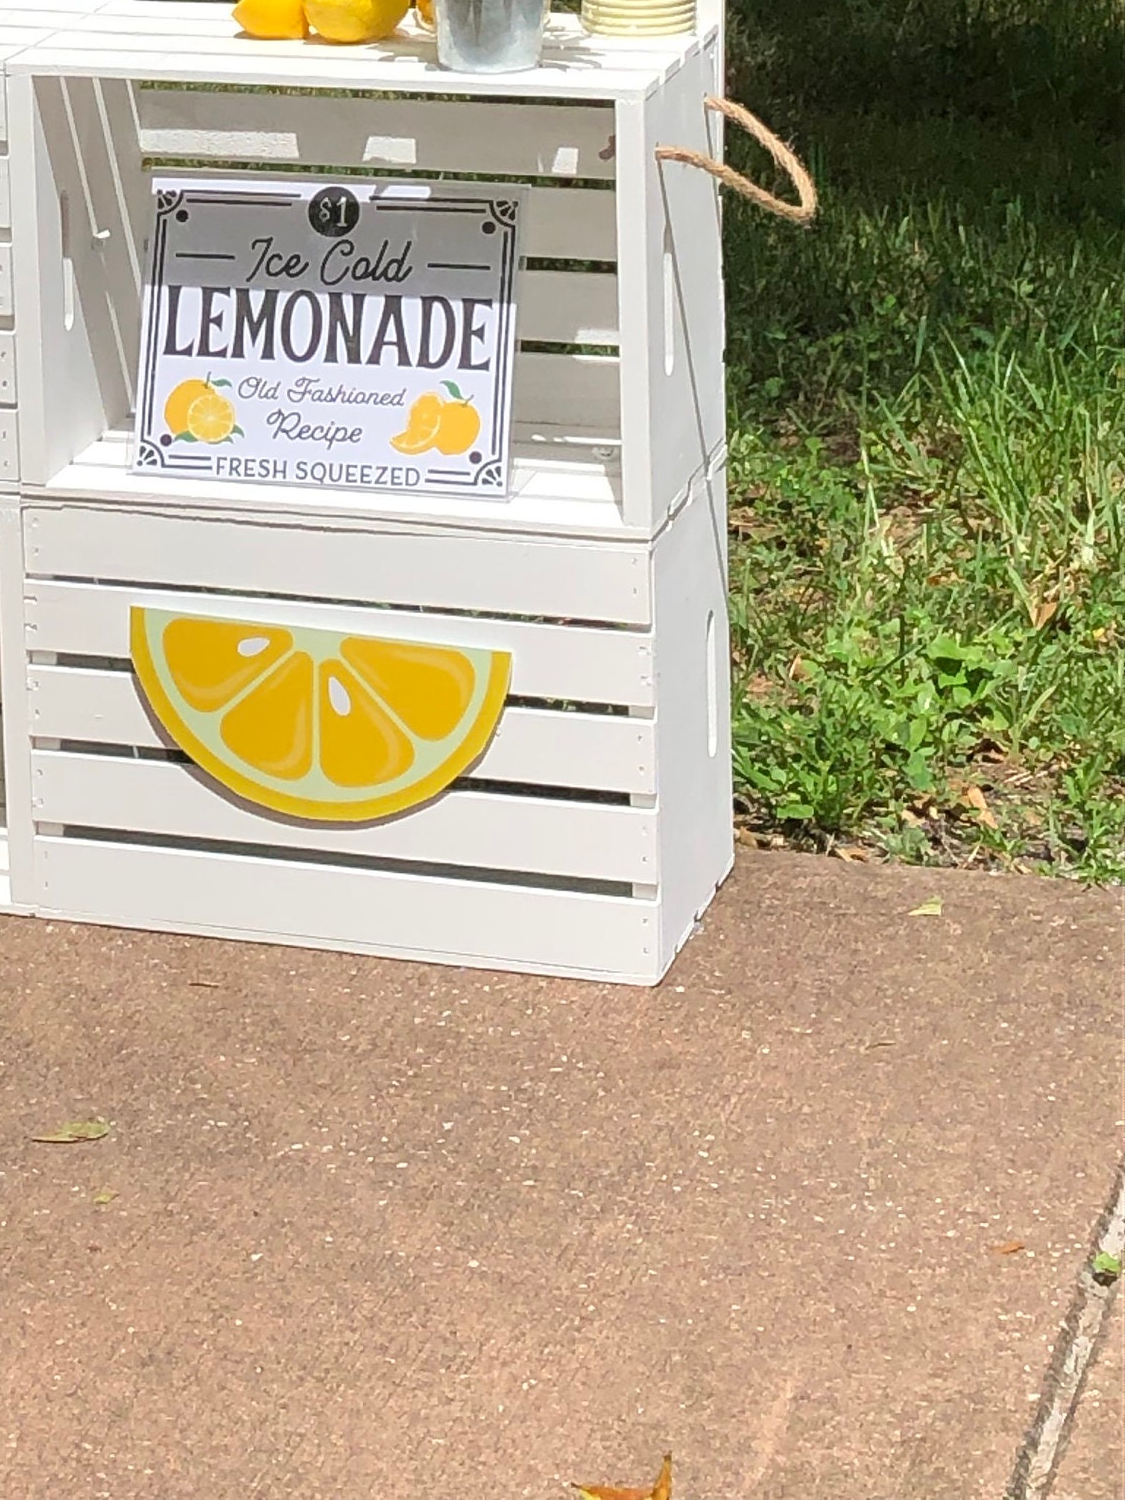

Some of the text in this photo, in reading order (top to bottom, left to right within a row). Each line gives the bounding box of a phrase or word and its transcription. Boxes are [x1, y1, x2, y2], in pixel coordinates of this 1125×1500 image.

[317, 195, 351, 228] $1
[245, 237, 413, 286] Ice Cold
[163, 284, 493, 372] LEMONADE
[237, 376, 406, 408] Old Fashioned
[266, 409, 363, 451] Recipe
[215, 457, 421, 487] FRESH SQUEEZED
